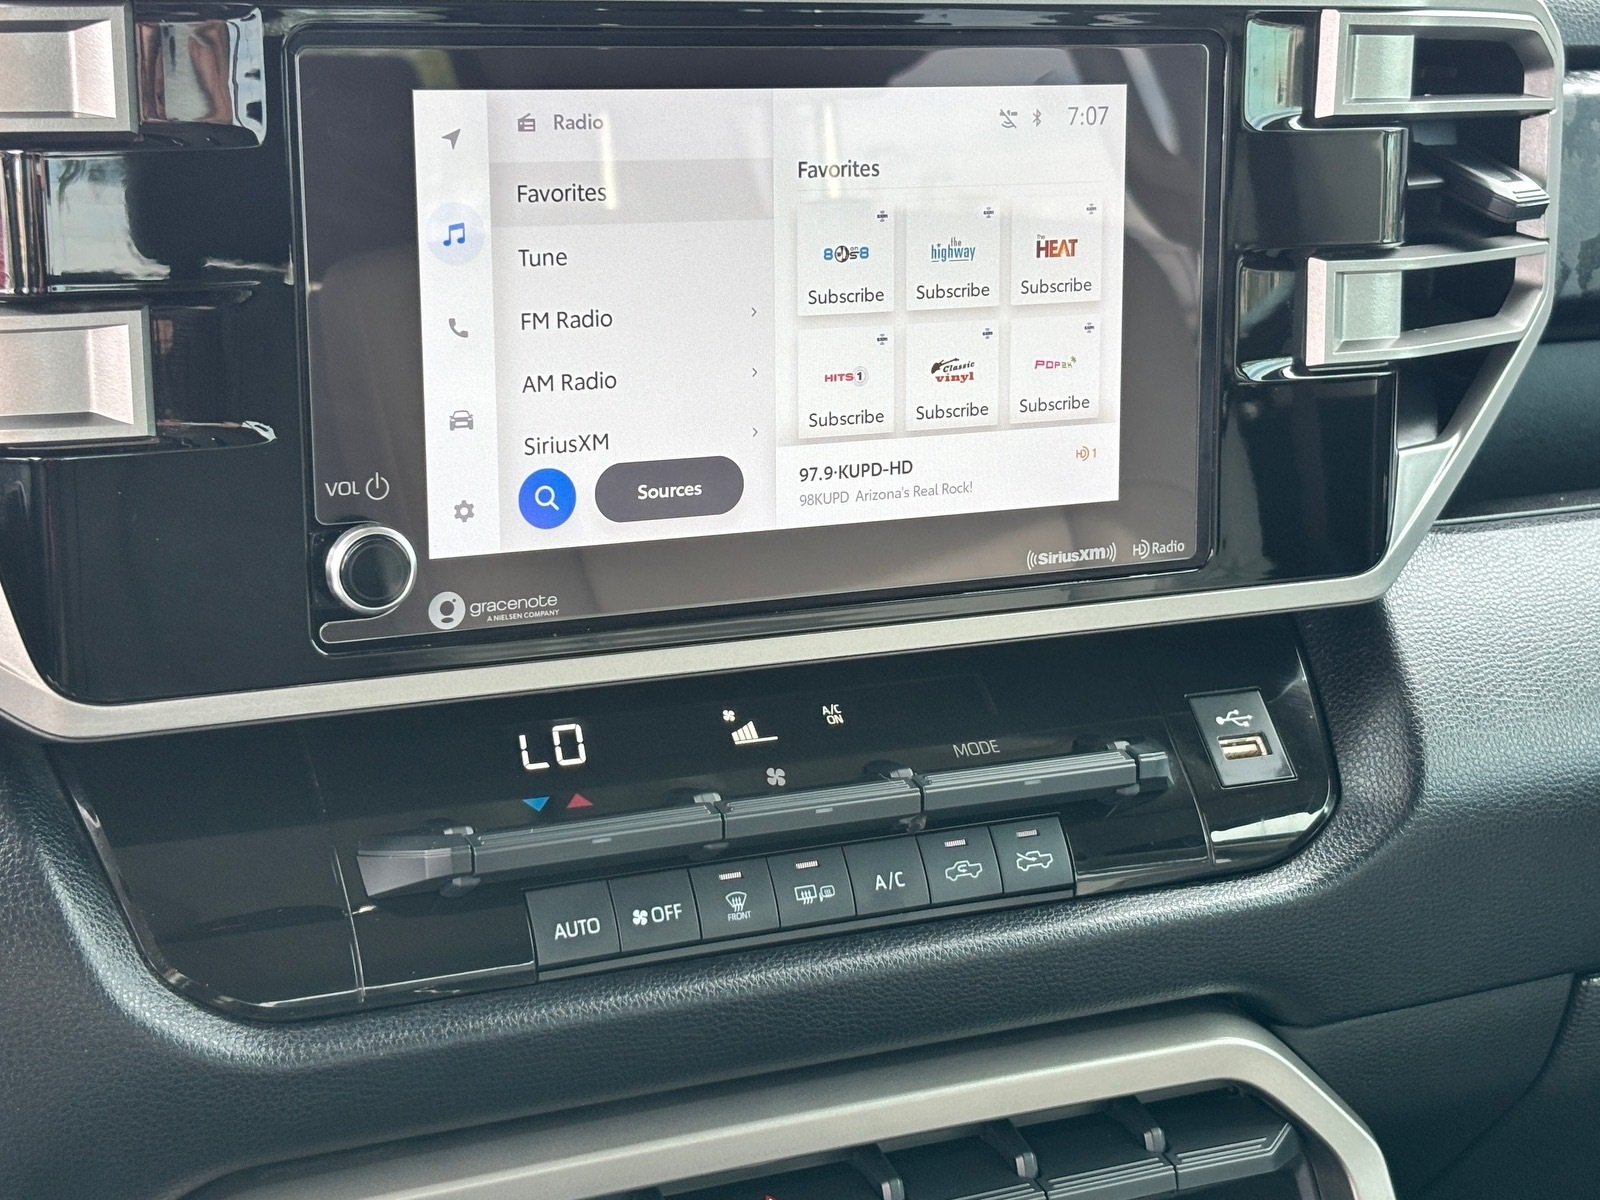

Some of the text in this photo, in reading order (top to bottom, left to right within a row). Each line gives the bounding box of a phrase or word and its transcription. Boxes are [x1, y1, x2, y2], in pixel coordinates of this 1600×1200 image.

[553, 113, 604, 131] Radio
[1067, 106, 1109, 126] 7:07
[797, 159, 880, 179] Favorites
[516, 183, 607, 203] Favorites
[950, 236, 962, 246] the
[1035, 239, 1078, 258] HEAT
[518, 249, 568, 267] Tune
[931, 244, 976, 262] highway
[916, 283, 991, 300] Subscribe
[1020, 277, 1093, 295] Subscribe
[807, 288, 885, 305] Subscribe
[520, 309, 613, 330] FM Radio
[942, 361, 975, 373] Classic
[522, 372, 618, 393] AM Radio
[824, 372, 854, 382] HITS
[935, 371, 974, 383] vinyl
[915, 401, 989, 420] Subscribe
[1019, 395, 1091, 413] Subscribe
[808, 409, 885, 428] Subscribe
[523, 432, 610, 455] SiriusXM
[325, 480, 360, 497] VOL
[637, 482, 703, 501] Sources
[799, 481, 973, 507] 98KUPD Arizona's Real Rock!
[1151, 540, 1185, 554] Radio
[469, 594, 558, 617] gracenote
[493, 613, 523, 621] NIELSEN
[523, 609, 560, 619] COMPANY
[822, 703, 842, 715] A/C
[826, 714, 844, 724] ON
[518, 723, 587, 771] LO
[952, 739, 1000, 758] MODE
[874, 871, 906, 891] A/C
[650, 903, 683, 923] OFF
[726, 909, 751, 921] FRONT
[554, 916, 601, 941] AUTO
